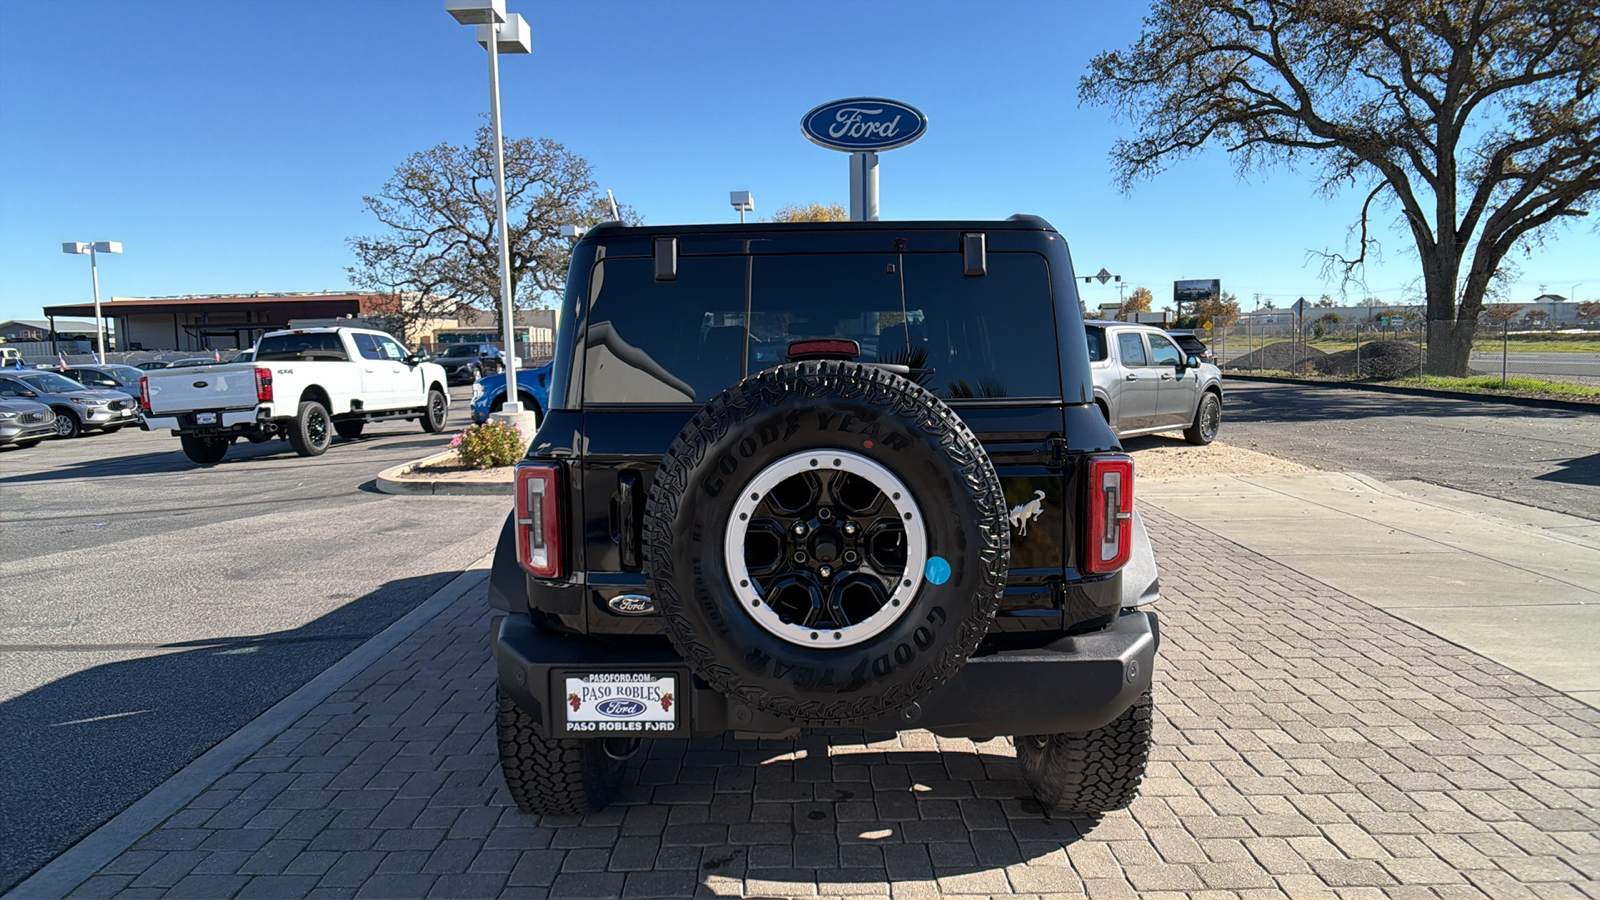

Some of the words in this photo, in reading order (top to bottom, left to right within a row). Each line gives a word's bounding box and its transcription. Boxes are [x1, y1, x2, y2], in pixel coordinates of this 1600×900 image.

[829, 108, 901, 138] Ford
[619, 598, 646, 611] Ford
[588, 673, 651, 683] PASOFORD.COM
[582, 686, 612, 703] PASO
[616, 686, 661, 703] ROBLES
[605, 701, 637, 714] Ford
[566, 722, 596, 731] PASO
[599, 722, 642, 731] ROBLES
[645, 722, 675, 731] FORD
